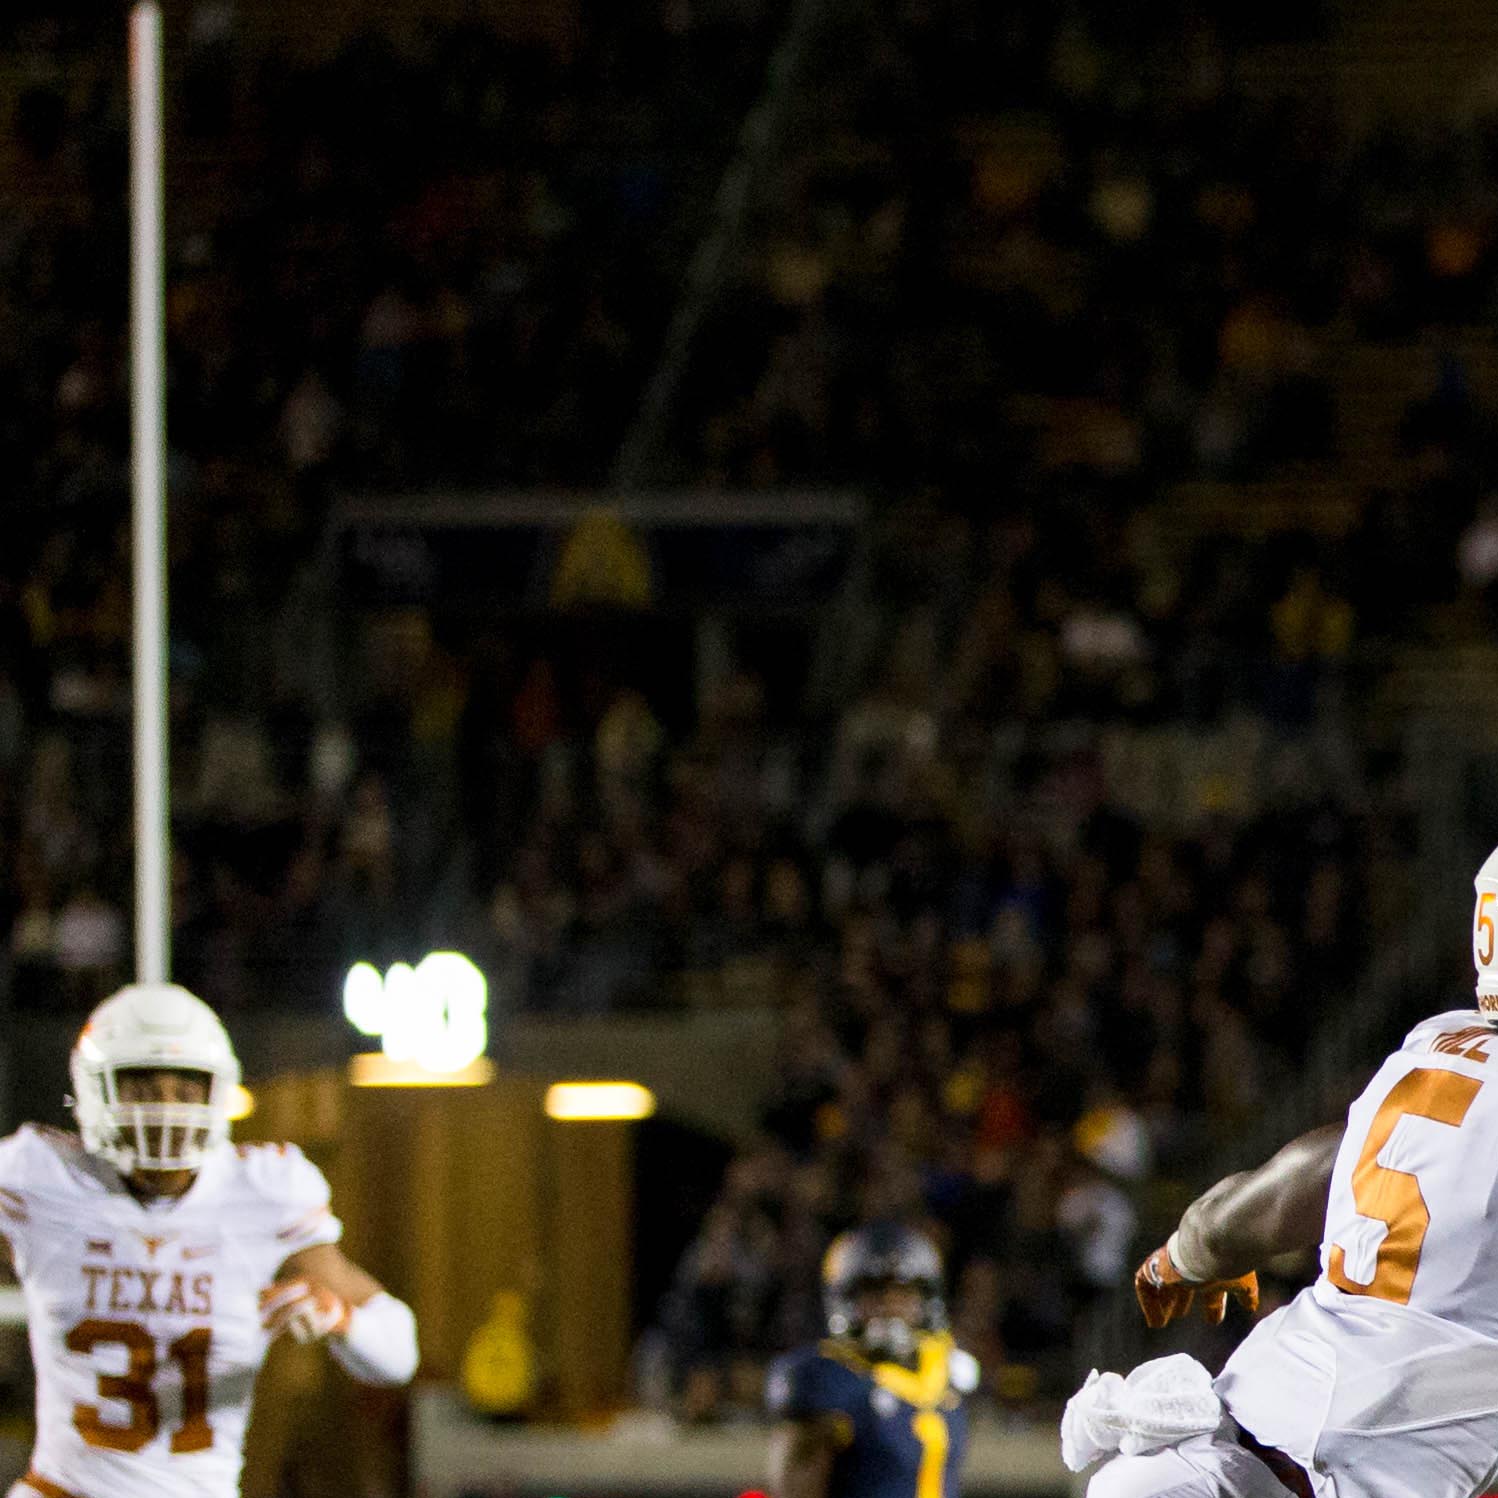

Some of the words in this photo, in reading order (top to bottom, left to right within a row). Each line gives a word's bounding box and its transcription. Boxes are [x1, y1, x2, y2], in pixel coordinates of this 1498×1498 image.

[1477, 892, 1497, 967] 5
[1327, 1067, 1485, 1306] 5
[81, 1264, 213, 1315] TEXAS
[65, 1316, 215, 1455] 31
